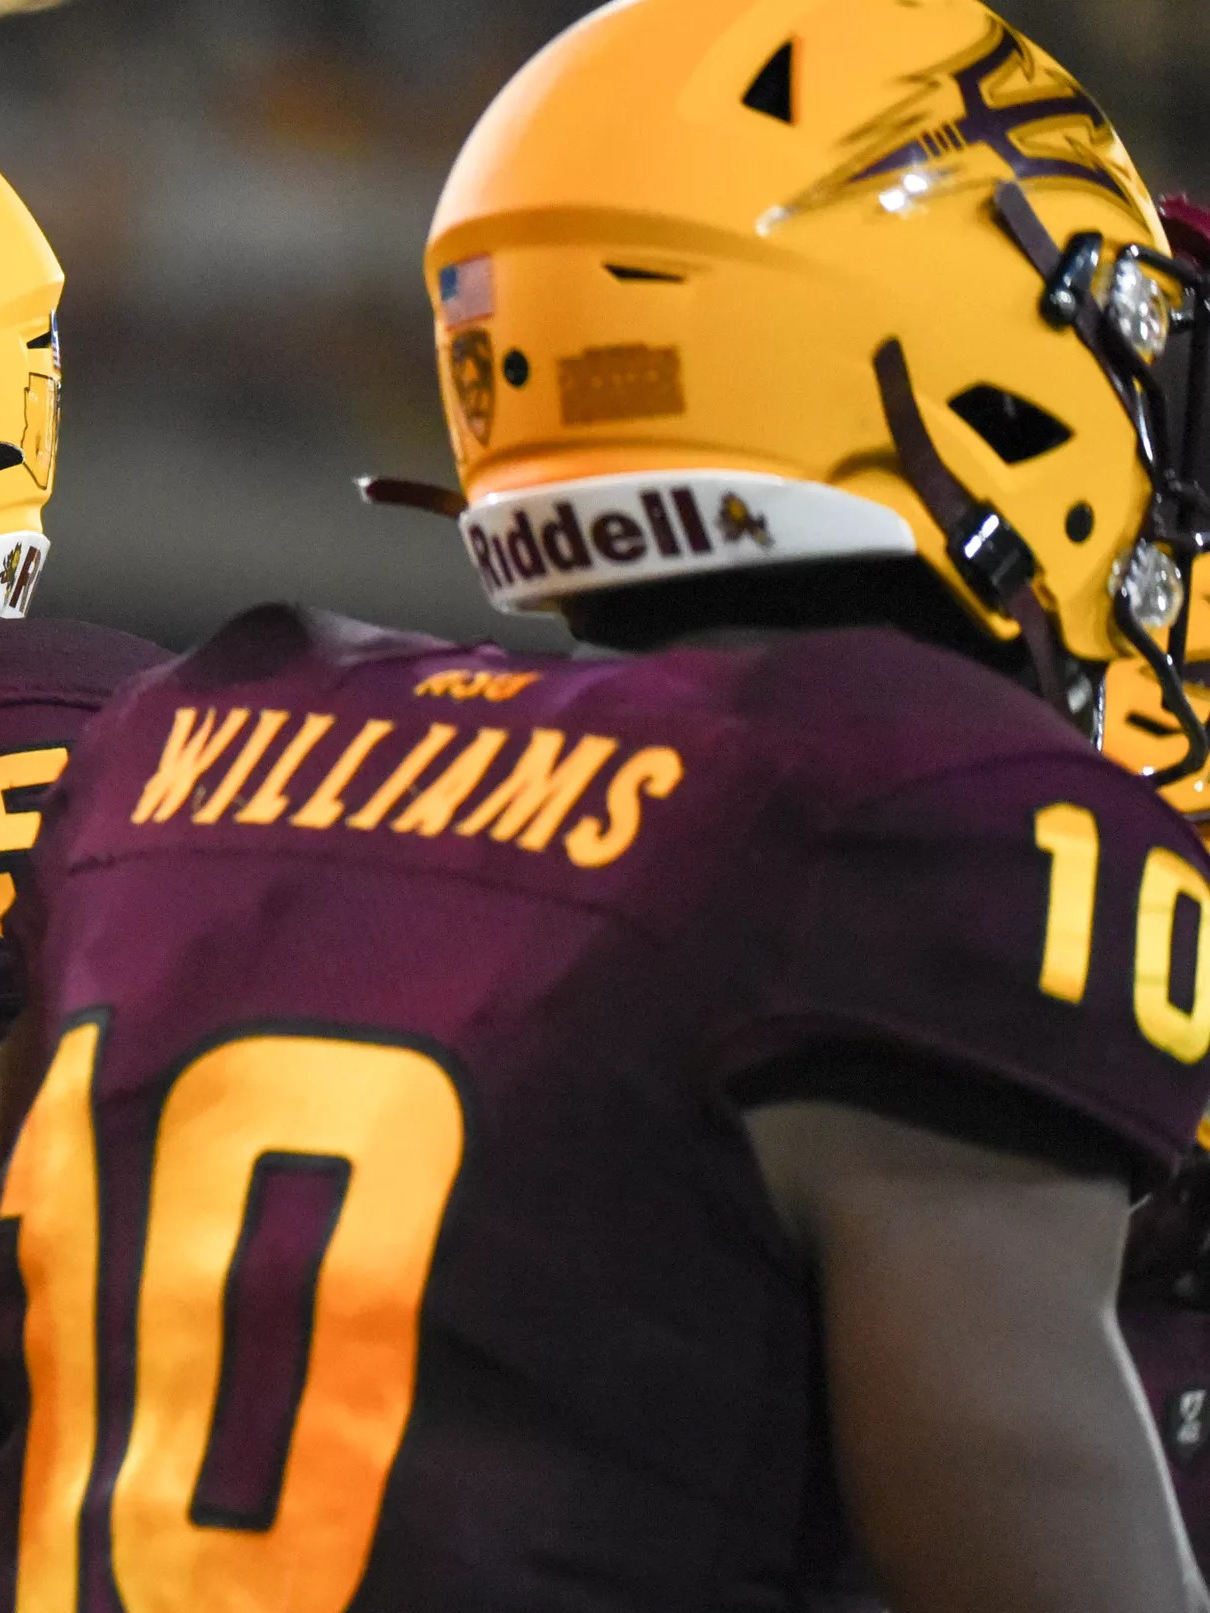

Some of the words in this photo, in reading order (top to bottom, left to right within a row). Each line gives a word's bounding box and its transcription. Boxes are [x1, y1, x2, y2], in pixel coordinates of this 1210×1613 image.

[469, 487, 712, 588] Riddell
[130, 707, 684, 868] WILLIAMS
[1034, 802, 1210, 1064] 10
